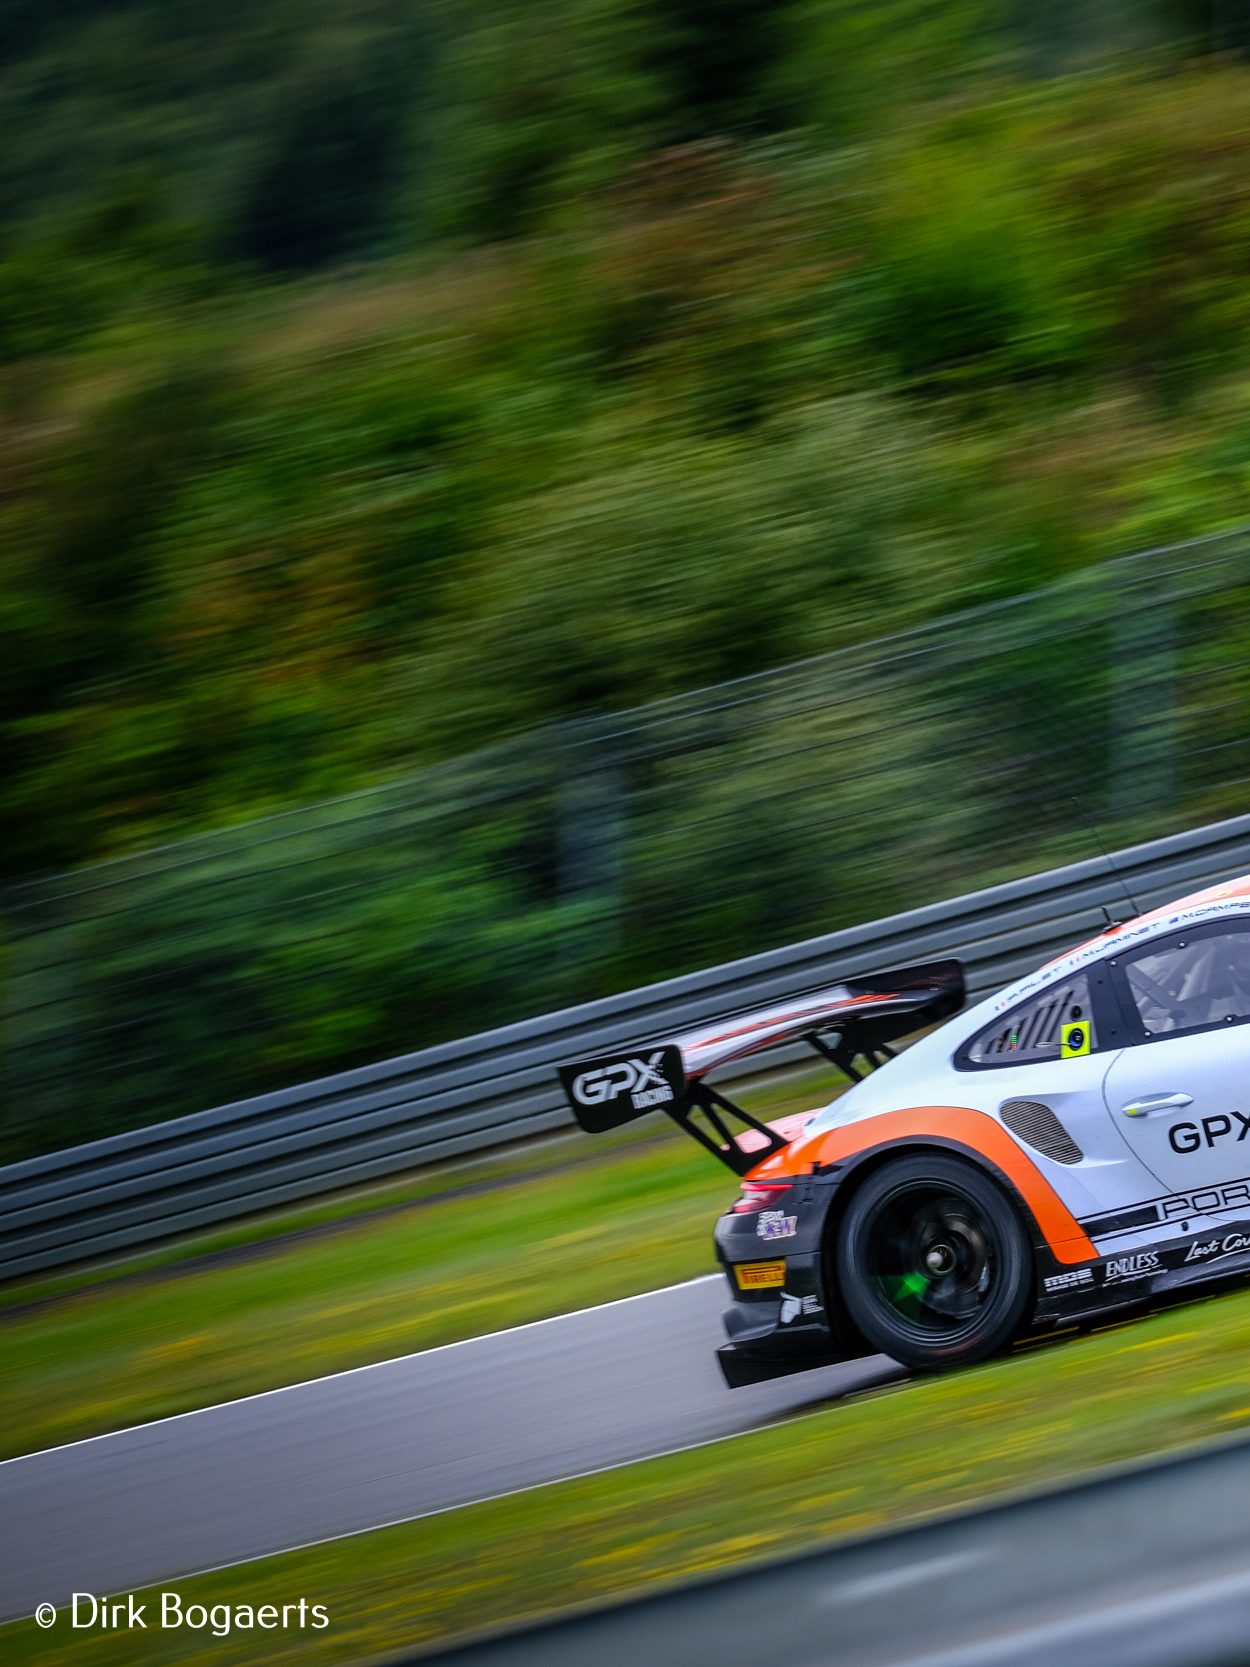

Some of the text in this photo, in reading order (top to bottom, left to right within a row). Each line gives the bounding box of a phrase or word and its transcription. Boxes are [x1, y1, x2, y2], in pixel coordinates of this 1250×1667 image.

[572, 1051, 670, 1105] GPX
[1105, 1251, 1159, 1278] ENDLESS
[1184, 1240, 1220, 1262] Last
